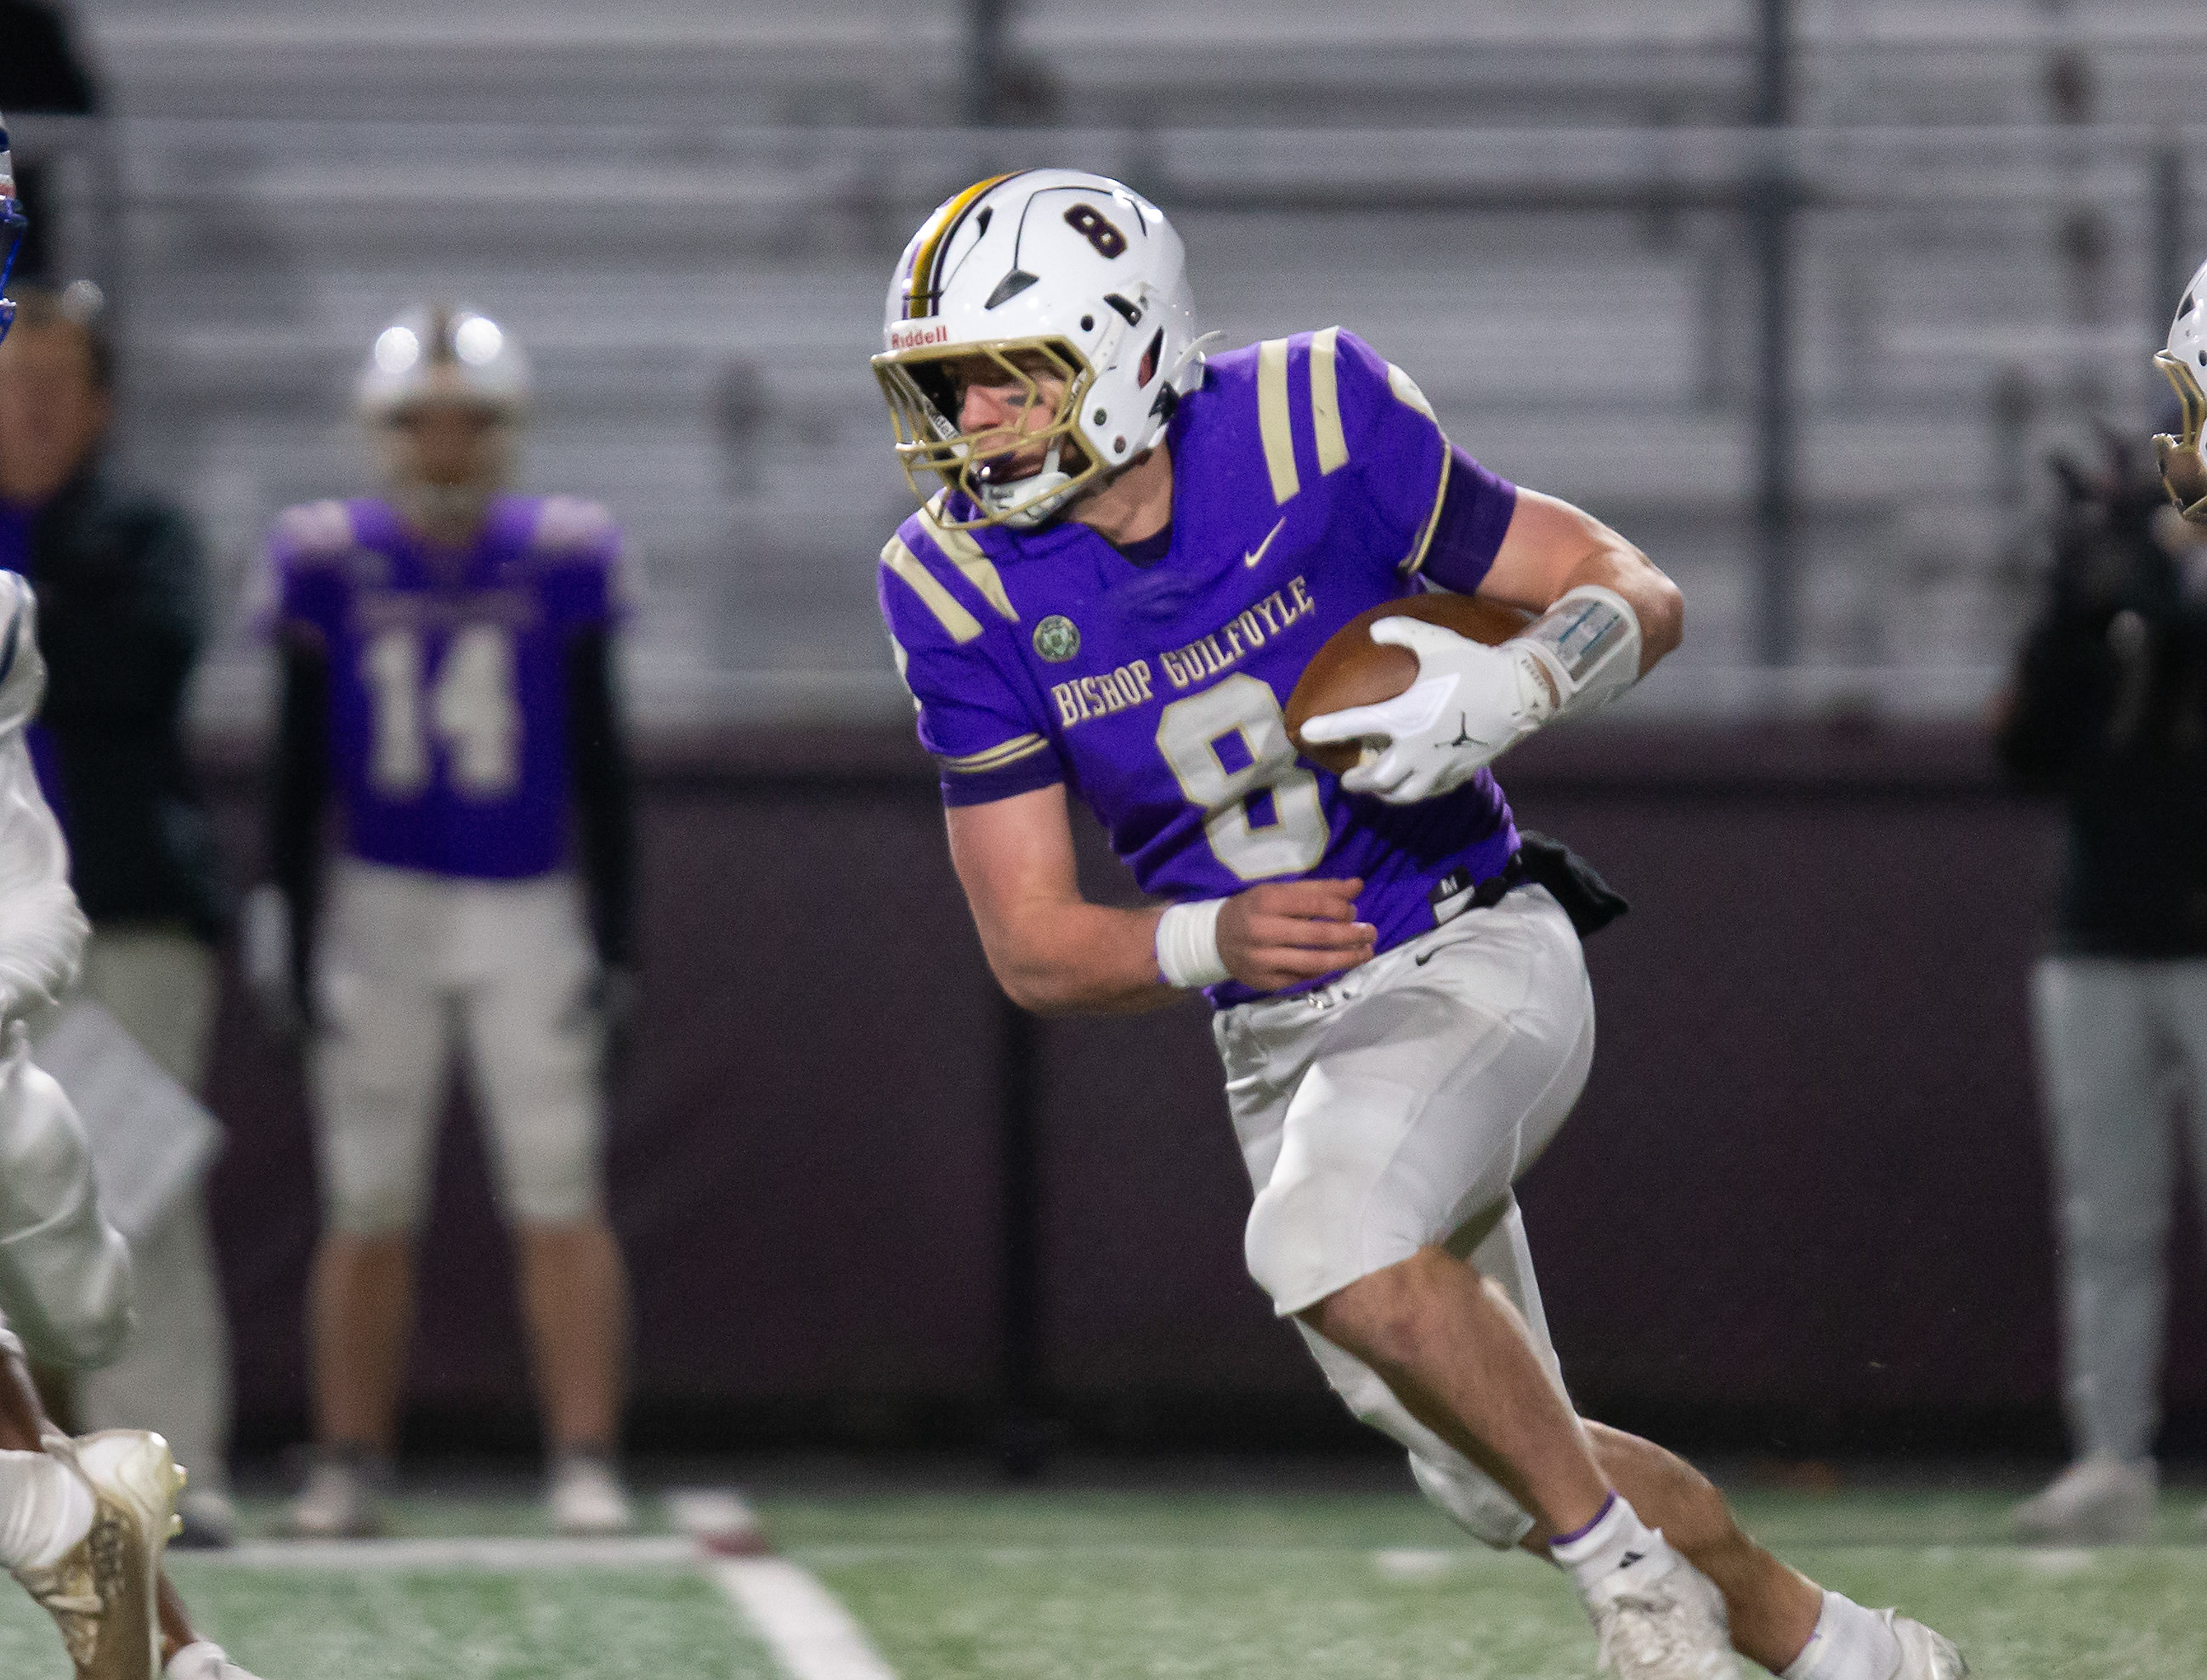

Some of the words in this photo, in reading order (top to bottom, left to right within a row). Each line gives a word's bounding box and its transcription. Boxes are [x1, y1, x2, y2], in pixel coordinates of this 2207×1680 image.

[1063, 202, 1127, 259] 8
[892, 325, 948, 348] Riddell
[363, 623, 521, 800] 14
[1051, 659, 1154, 729] BISHOP
[1159, 575, 1315, 689] GUILFOYLE
[1156, 672, 1331, 881] 8
